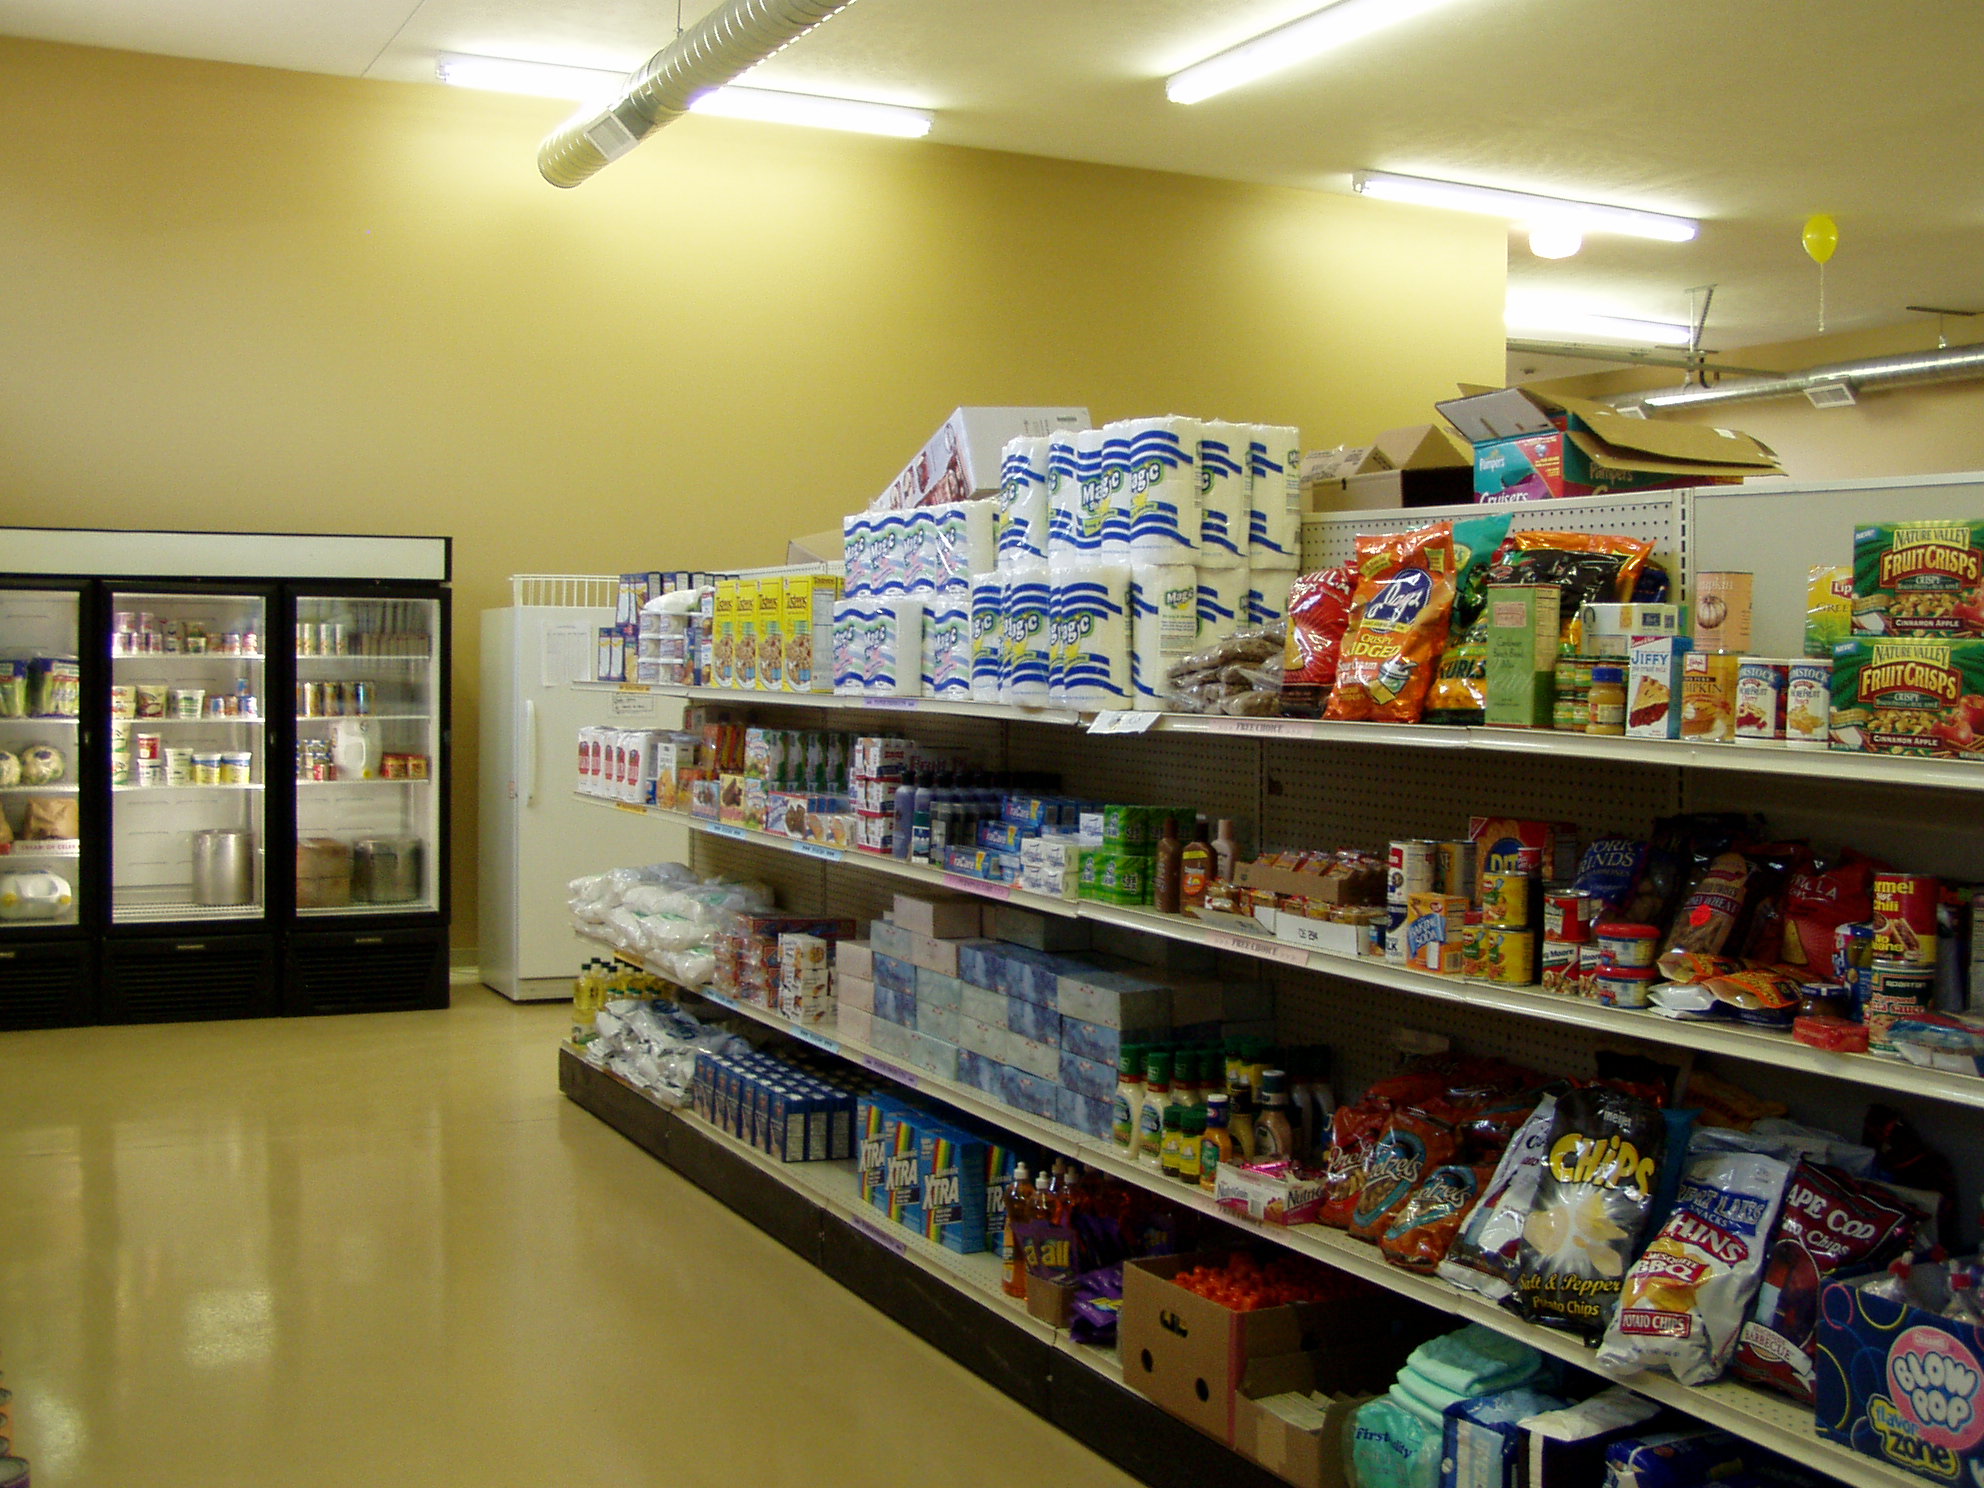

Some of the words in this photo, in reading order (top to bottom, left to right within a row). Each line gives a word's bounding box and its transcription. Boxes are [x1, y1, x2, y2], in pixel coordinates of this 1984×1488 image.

[1480, 457, 1504, 471] Pampers
[1480, 491, 1528, 503] Cruisers
[1895, 530, 1932, 550] NATURE
[1934, 528, 1969, 549] VALLEY
[1915, 575, 1941, 584] CRISPY
[1895, 619, 1934, 628] CINNAMON
[1936, 620, 1960, 628] APPLE
[1361, 634, 1394, 645] CRISPY
[1632, 650, 1668, 665] JIFFY
[1875, 646, 1910, 667] NATURE
[1912, 646, 1949, 670] VALLEY
[1874, 735, 1912, 744] CINNAMON
[1914, 738, 1938, 747] APPLE
[1550, 949, 1575, 958] Moore
[859, 1139, 886, 1172] XTRA
[886, 1156, 918, 1191] XTRA
[922, 1174, 960, 1210] XTRA
[1827, 1210, 1875, 1239] COD
[1040, 1240, 1071, 1268] all
[1637, 1259, 1694, 1281] BBQ
[1519, 1274, 1541, 1291] Salt
[1544, 1272, 1559, 1291] &
[1561, 1273, 1622, 1297] Pepper
[1566, 1302, 1600, 1317] Chips
[1622, 1314, 1650, 1328] POTATO
[1652, 1315, 1685, 1332] CHIPS
[1893, 1352, 1980, 1398] BLOW
[1911, 1388, 1971, 1434] POP
[1356, 1427, 1391, 1442] first
